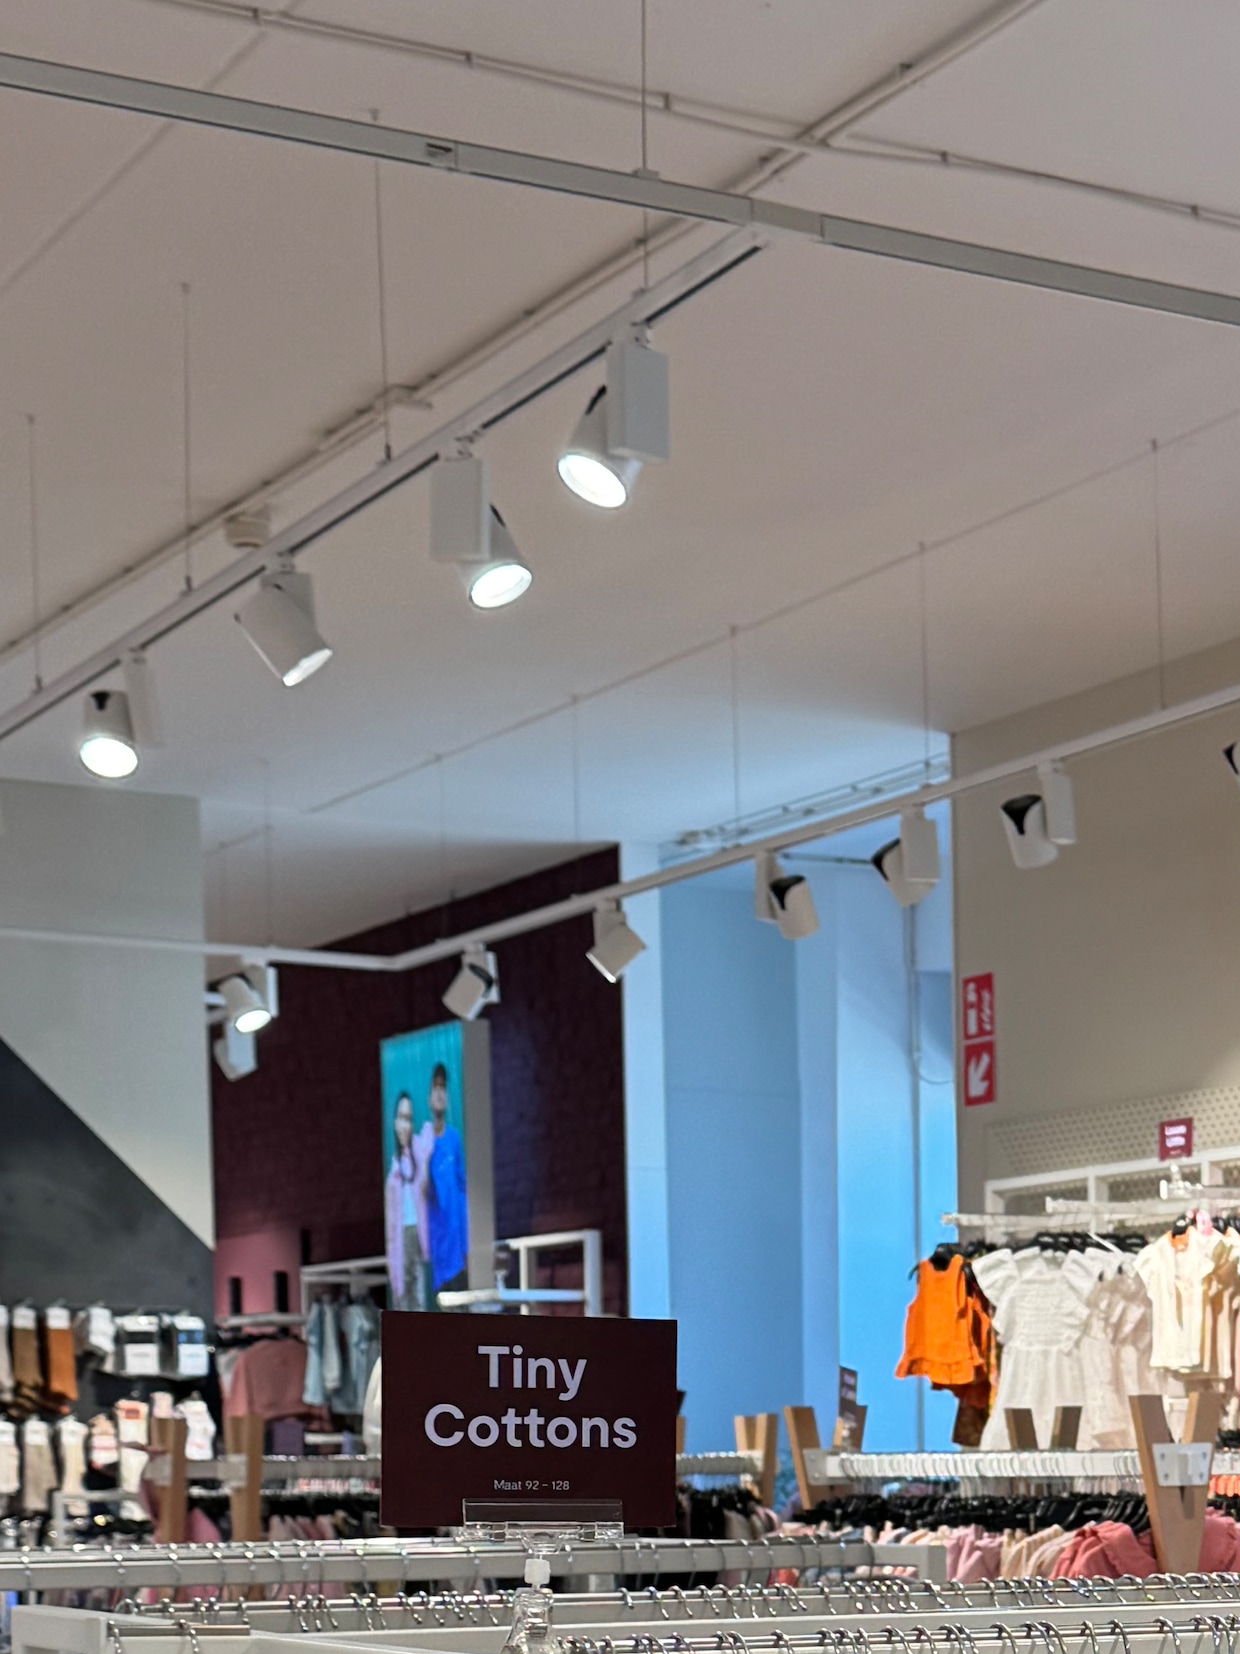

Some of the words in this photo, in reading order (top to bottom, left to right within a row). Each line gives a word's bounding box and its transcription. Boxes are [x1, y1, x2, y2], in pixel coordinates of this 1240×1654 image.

[477, 1345, 588, 1403] Tiny
[424, 1403, 638, 1450] Cottons
[493, 1479, 522, 1491] Maat
[525, 1480, 540, 1491] 92
[551, 1480, 570, 1491] 128
